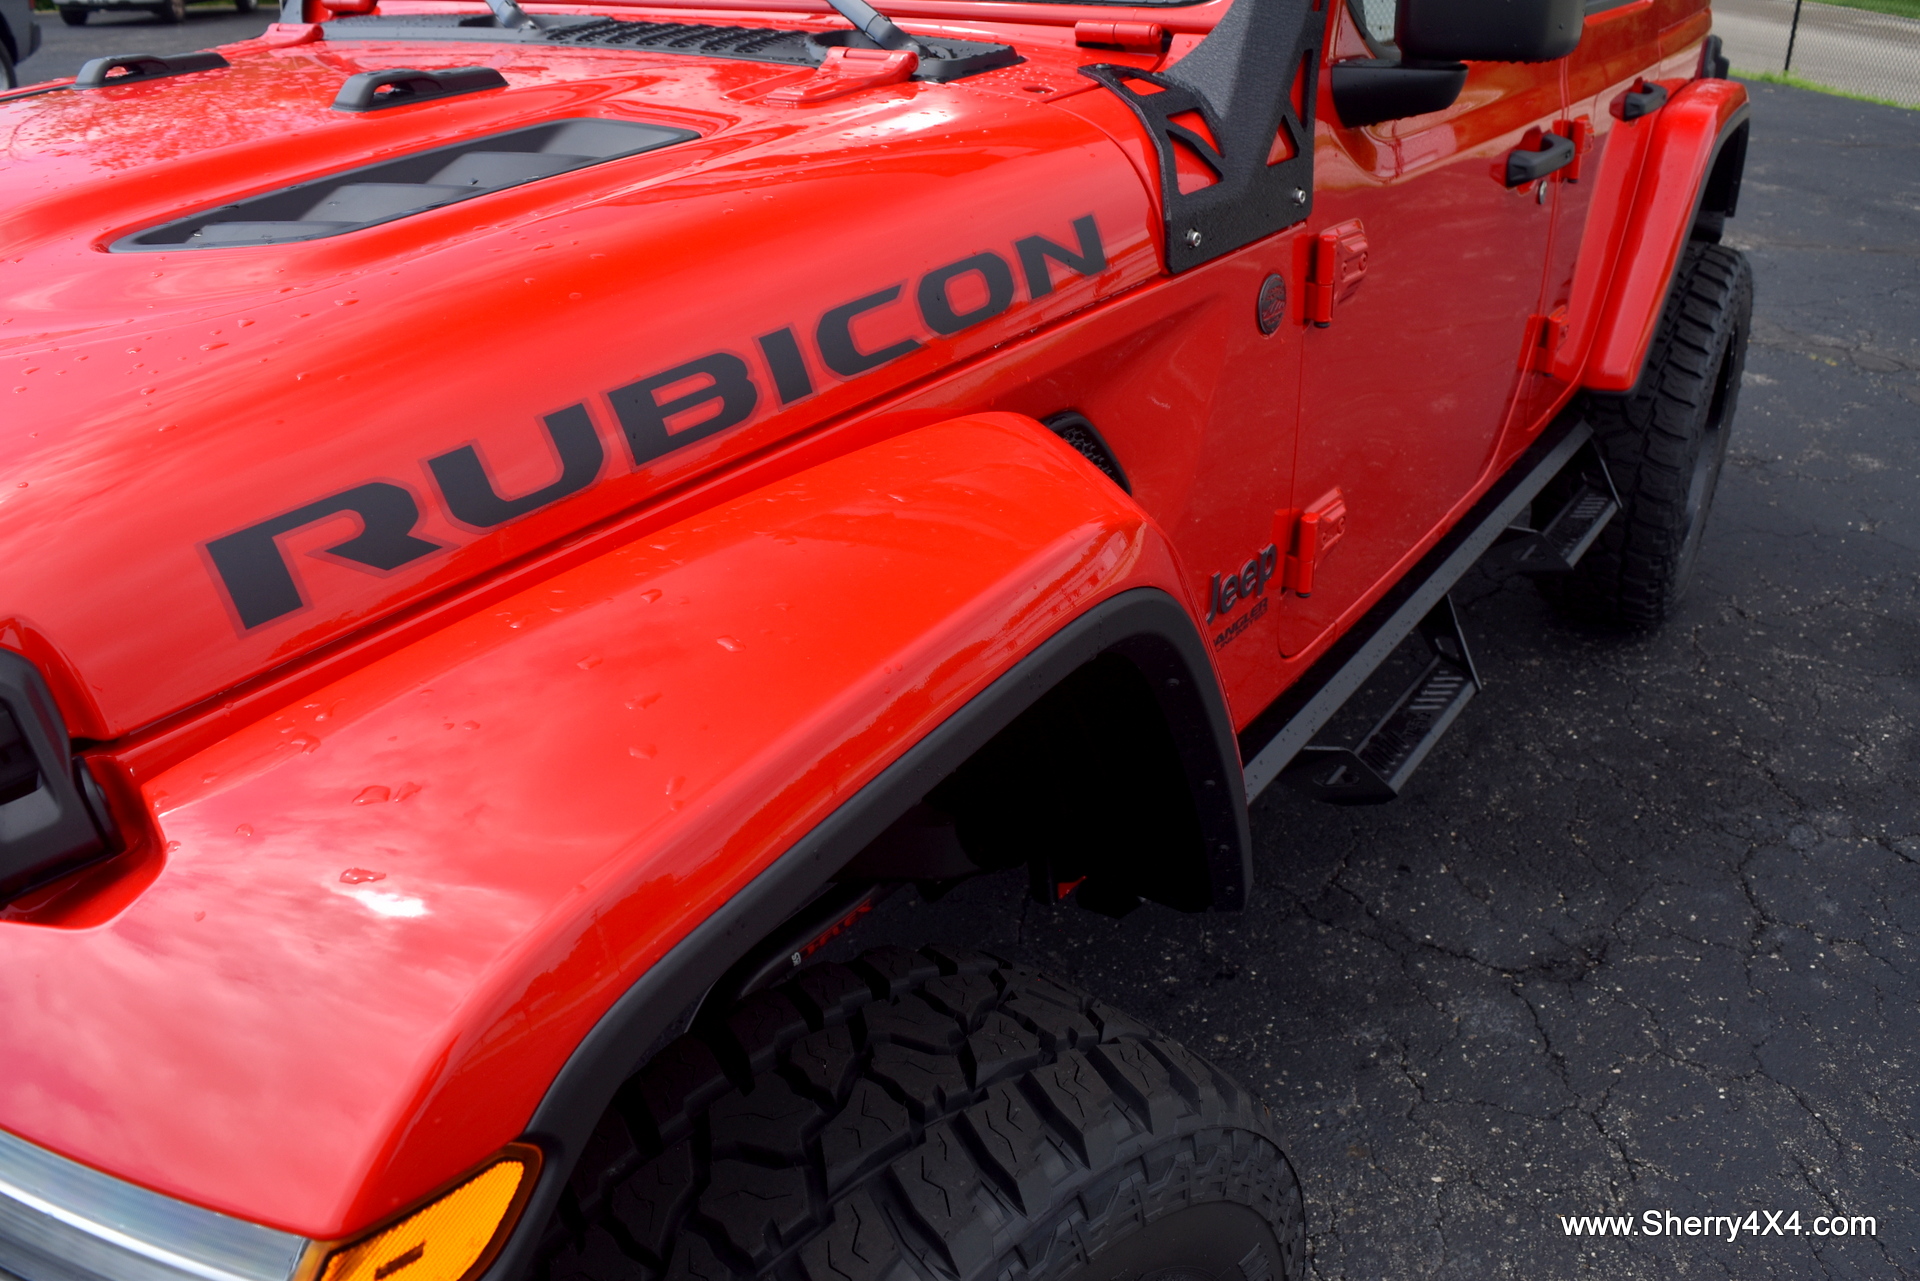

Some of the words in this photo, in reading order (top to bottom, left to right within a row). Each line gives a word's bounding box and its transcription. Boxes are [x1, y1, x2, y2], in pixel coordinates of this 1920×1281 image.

[205, 213, 1108, 630] RUBICON
[1206, 543, 1277, 626] Jeep
[1213, 597, 1268, 647] ANGLER
